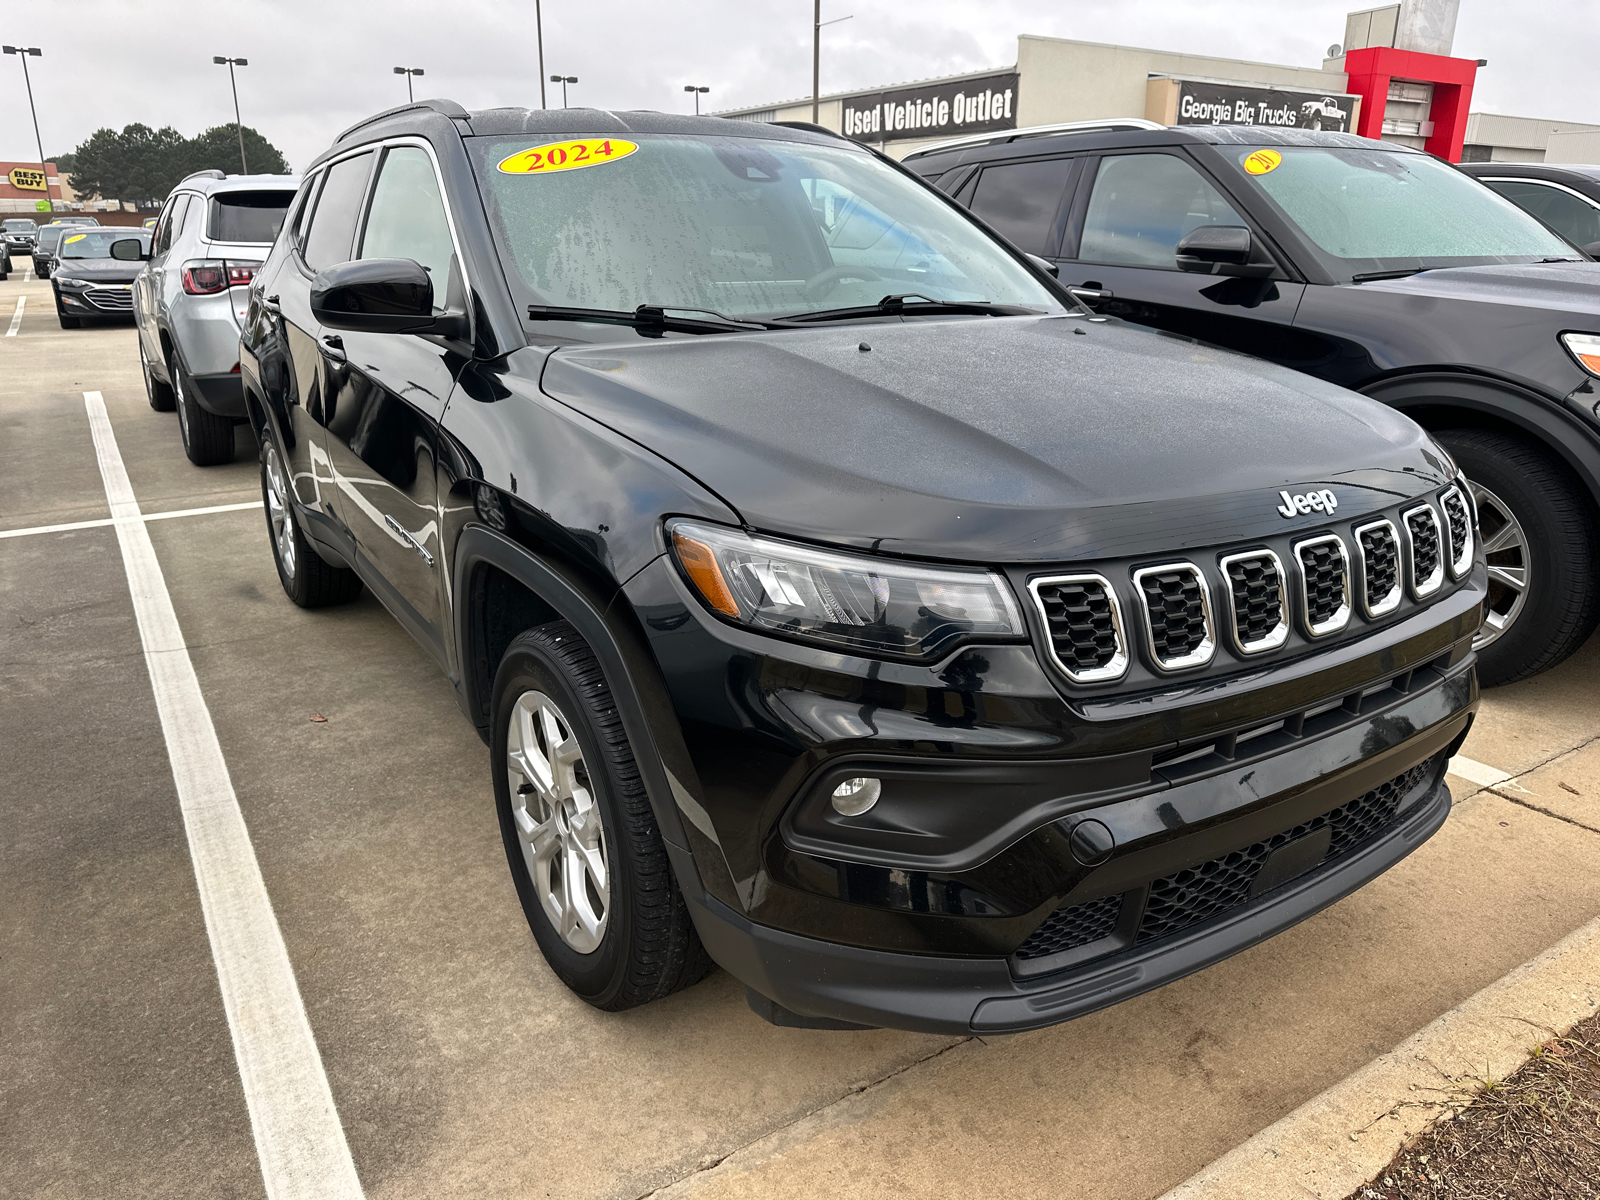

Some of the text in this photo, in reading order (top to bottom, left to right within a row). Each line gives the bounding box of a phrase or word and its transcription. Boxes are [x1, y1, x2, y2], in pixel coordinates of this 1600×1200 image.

[844, 88, 1013, 136] Used Vehicle Outlet
[1181, 95, 1297, 126] Georgia Big Trucks
[524, 140, 614, 172] 2024
[14, 170, 44, 180] BEST
[17, 179, 42, 187] BUY
[1276, 489, 1338, 518] Jeep
